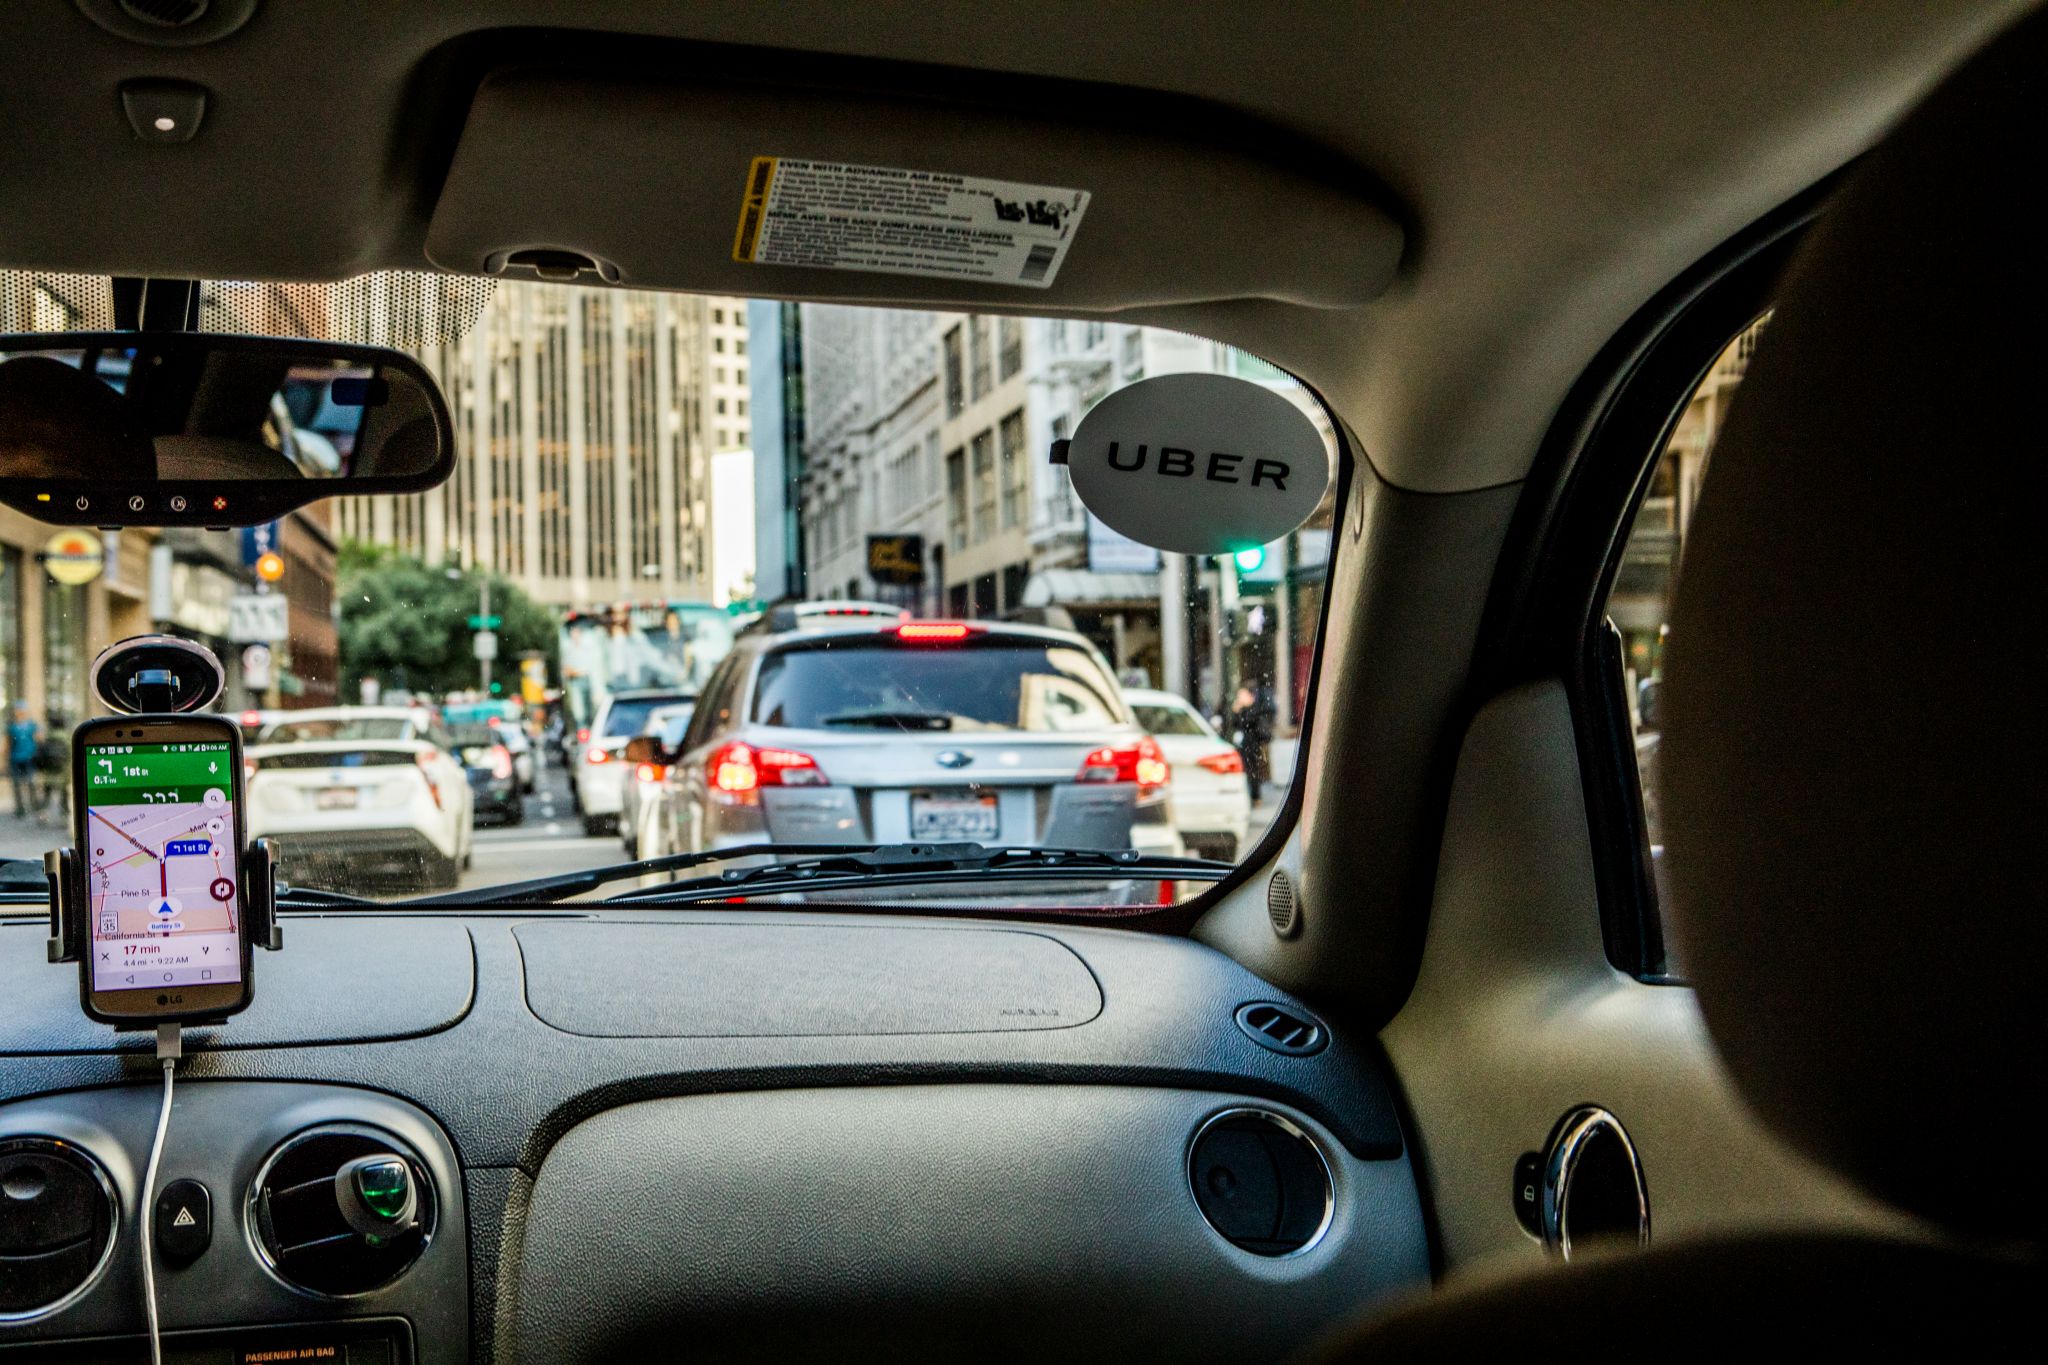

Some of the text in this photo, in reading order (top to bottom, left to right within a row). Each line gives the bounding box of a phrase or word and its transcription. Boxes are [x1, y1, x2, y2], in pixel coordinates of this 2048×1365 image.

[779, 160, 810, 170] EVEN
[812, 162, 843, 173] WITH
[1107, 441, 1290, 491] UBER
[123, 765, 140, 777] 1st
[182, 842, 207, 853] 1st St
[121, 888, 150, 899] Pine St
[103, 922, 116, 931] 35
[104, 930, 145, 941] California
[123, 944, 160, 955] 17 min
[123, 959, 136, 967] 4.4
[175, 956, 189, 964] AM
[245, 1346, 335, 1363] PASSENGER AIR BAG
